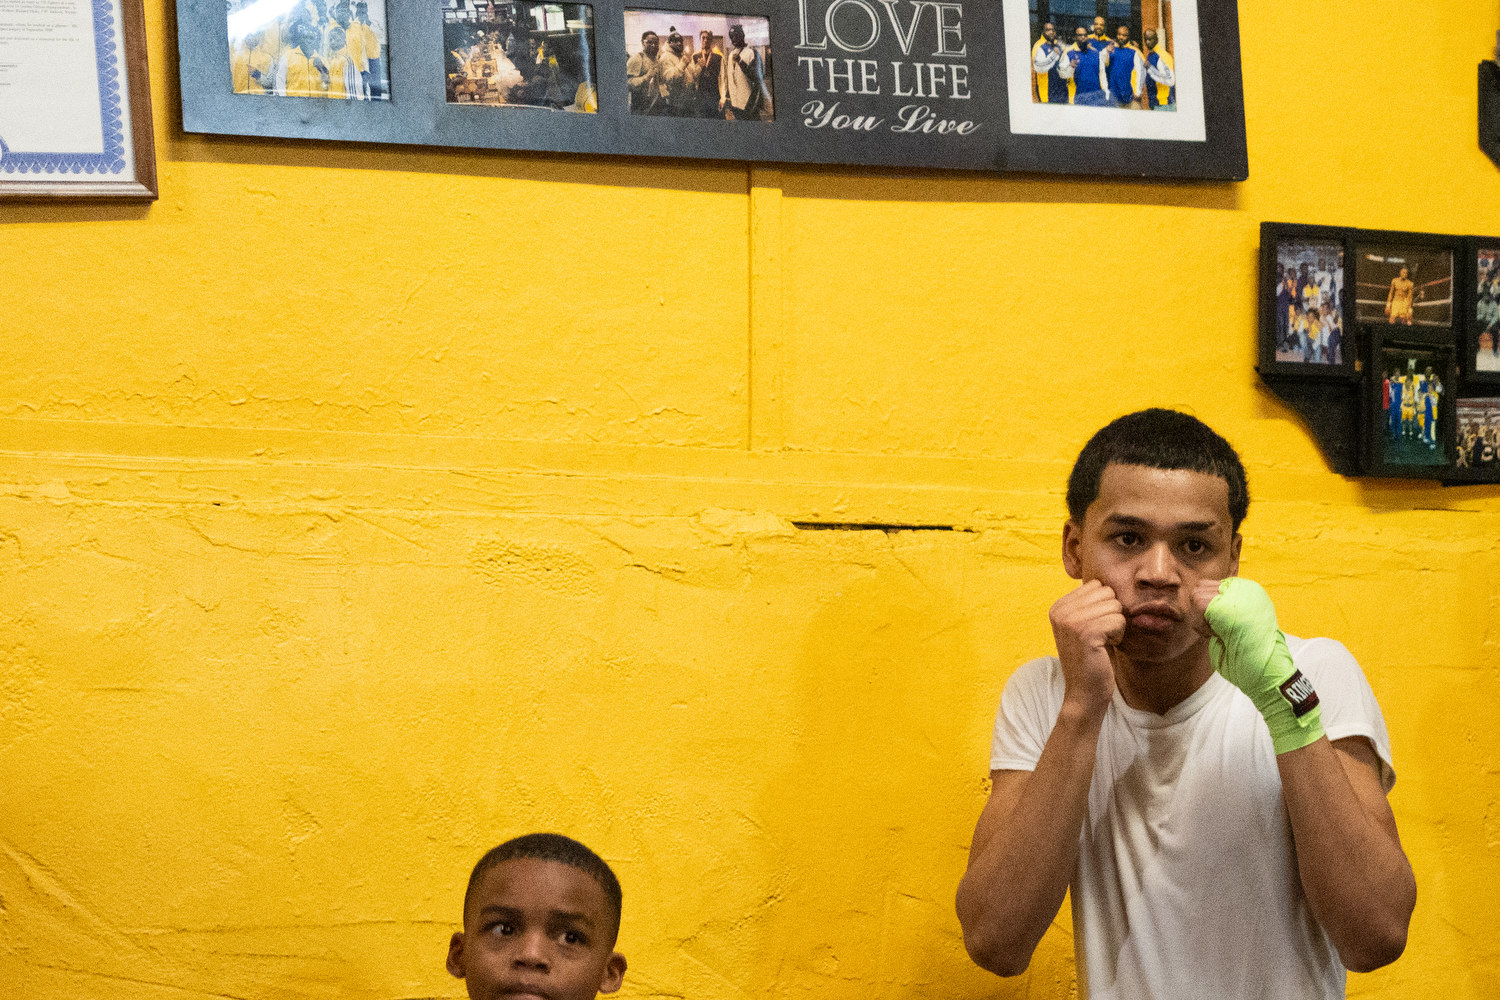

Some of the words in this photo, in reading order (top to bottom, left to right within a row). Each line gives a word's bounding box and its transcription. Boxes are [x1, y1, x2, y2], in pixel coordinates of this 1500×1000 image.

[794, 0, 967, 57] LOVE
[797, 56, 881, 95] THE
[890, 61, 972, 100] LIFE
[800, 99, 885, 131] You
[890, 104, 983, 136] Live
